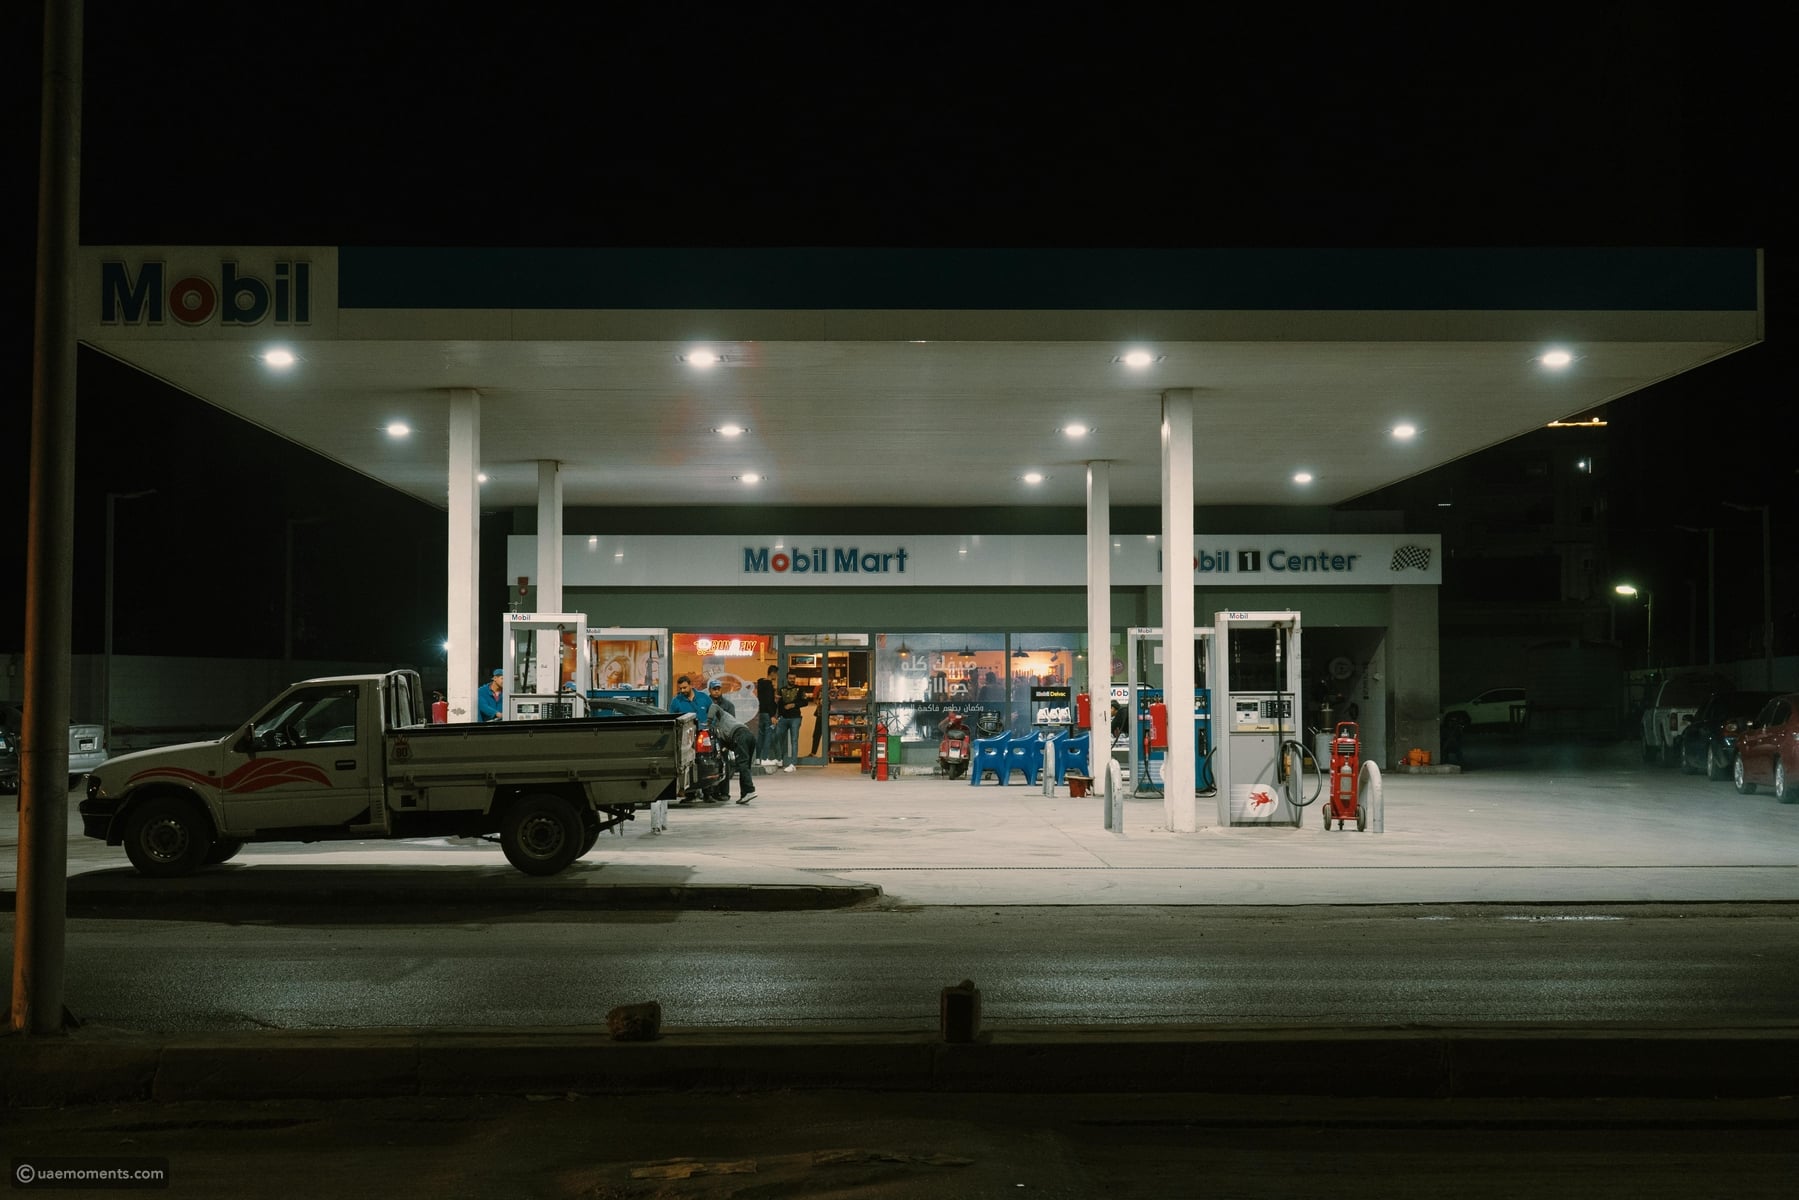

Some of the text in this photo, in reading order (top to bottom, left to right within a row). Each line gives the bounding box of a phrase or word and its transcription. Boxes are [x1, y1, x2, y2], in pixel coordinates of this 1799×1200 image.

[101, 261, 312, 325] Mobil
[743, 547, 908, 573] Mobil Mart
[1268, 549, 1355, 573] Center
[1110, 688, 1129, 697] Mob
